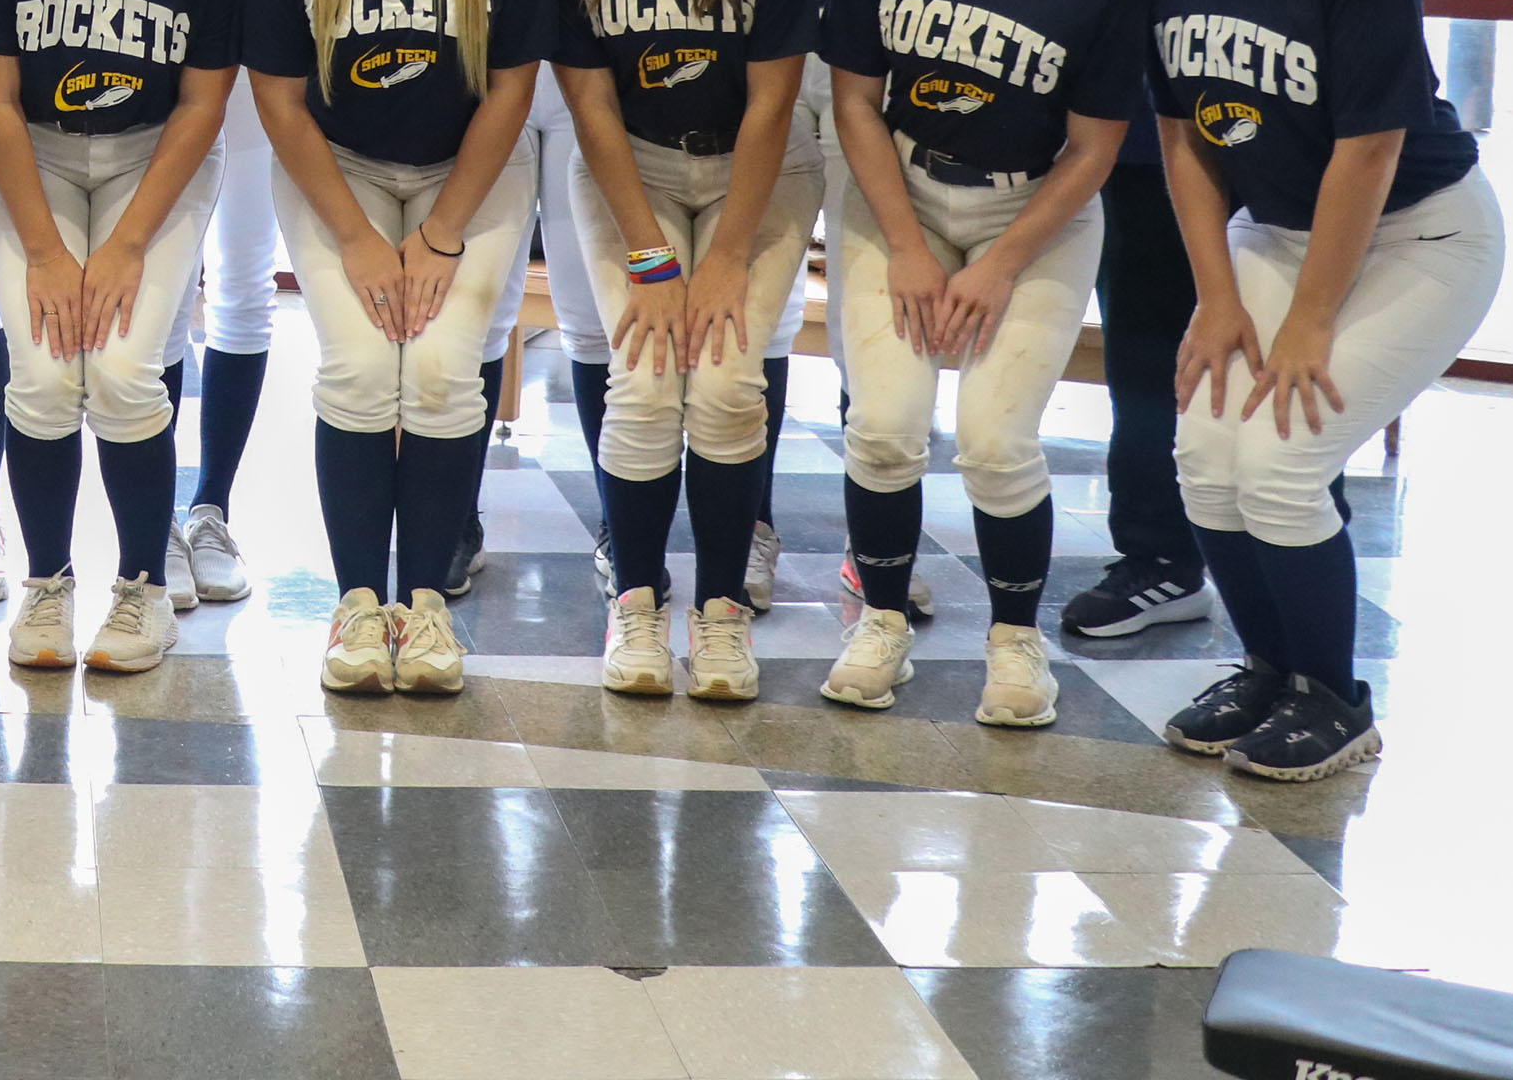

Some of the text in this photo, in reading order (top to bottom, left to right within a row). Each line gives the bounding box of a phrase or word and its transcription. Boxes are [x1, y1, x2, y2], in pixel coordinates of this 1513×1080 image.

[361, 48, 437, 72] SAU TECH
[645, 48, 718, 71] SAU TECH
[66, 72, 144, 94] SAU TECH
[919, 80, 996, 104] SAU TECH
[1201, 102, 1263, 127] SAU TECH
